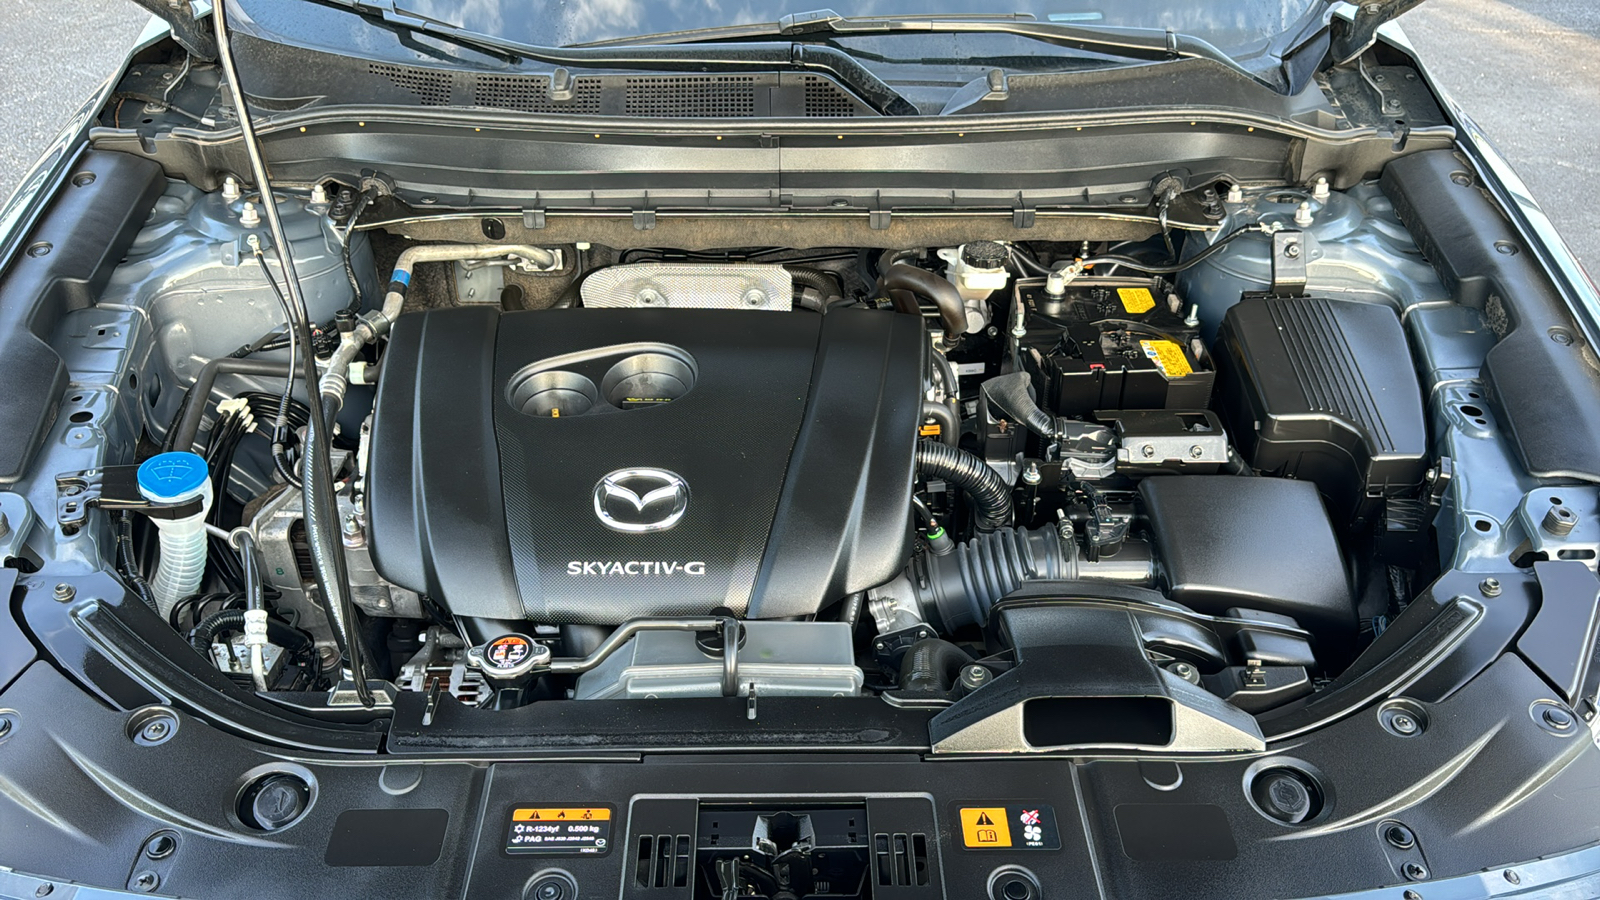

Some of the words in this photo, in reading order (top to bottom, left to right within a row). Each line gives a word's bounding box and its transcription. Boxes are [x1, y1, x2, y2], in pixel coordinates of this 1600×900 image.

[566, 561, 706, 575] SKYACTIV-G
[525, 825, 560, 834] R-1234yf
[589, 825, 600, 833] kg
[524, 835, 542, 843] PAG
